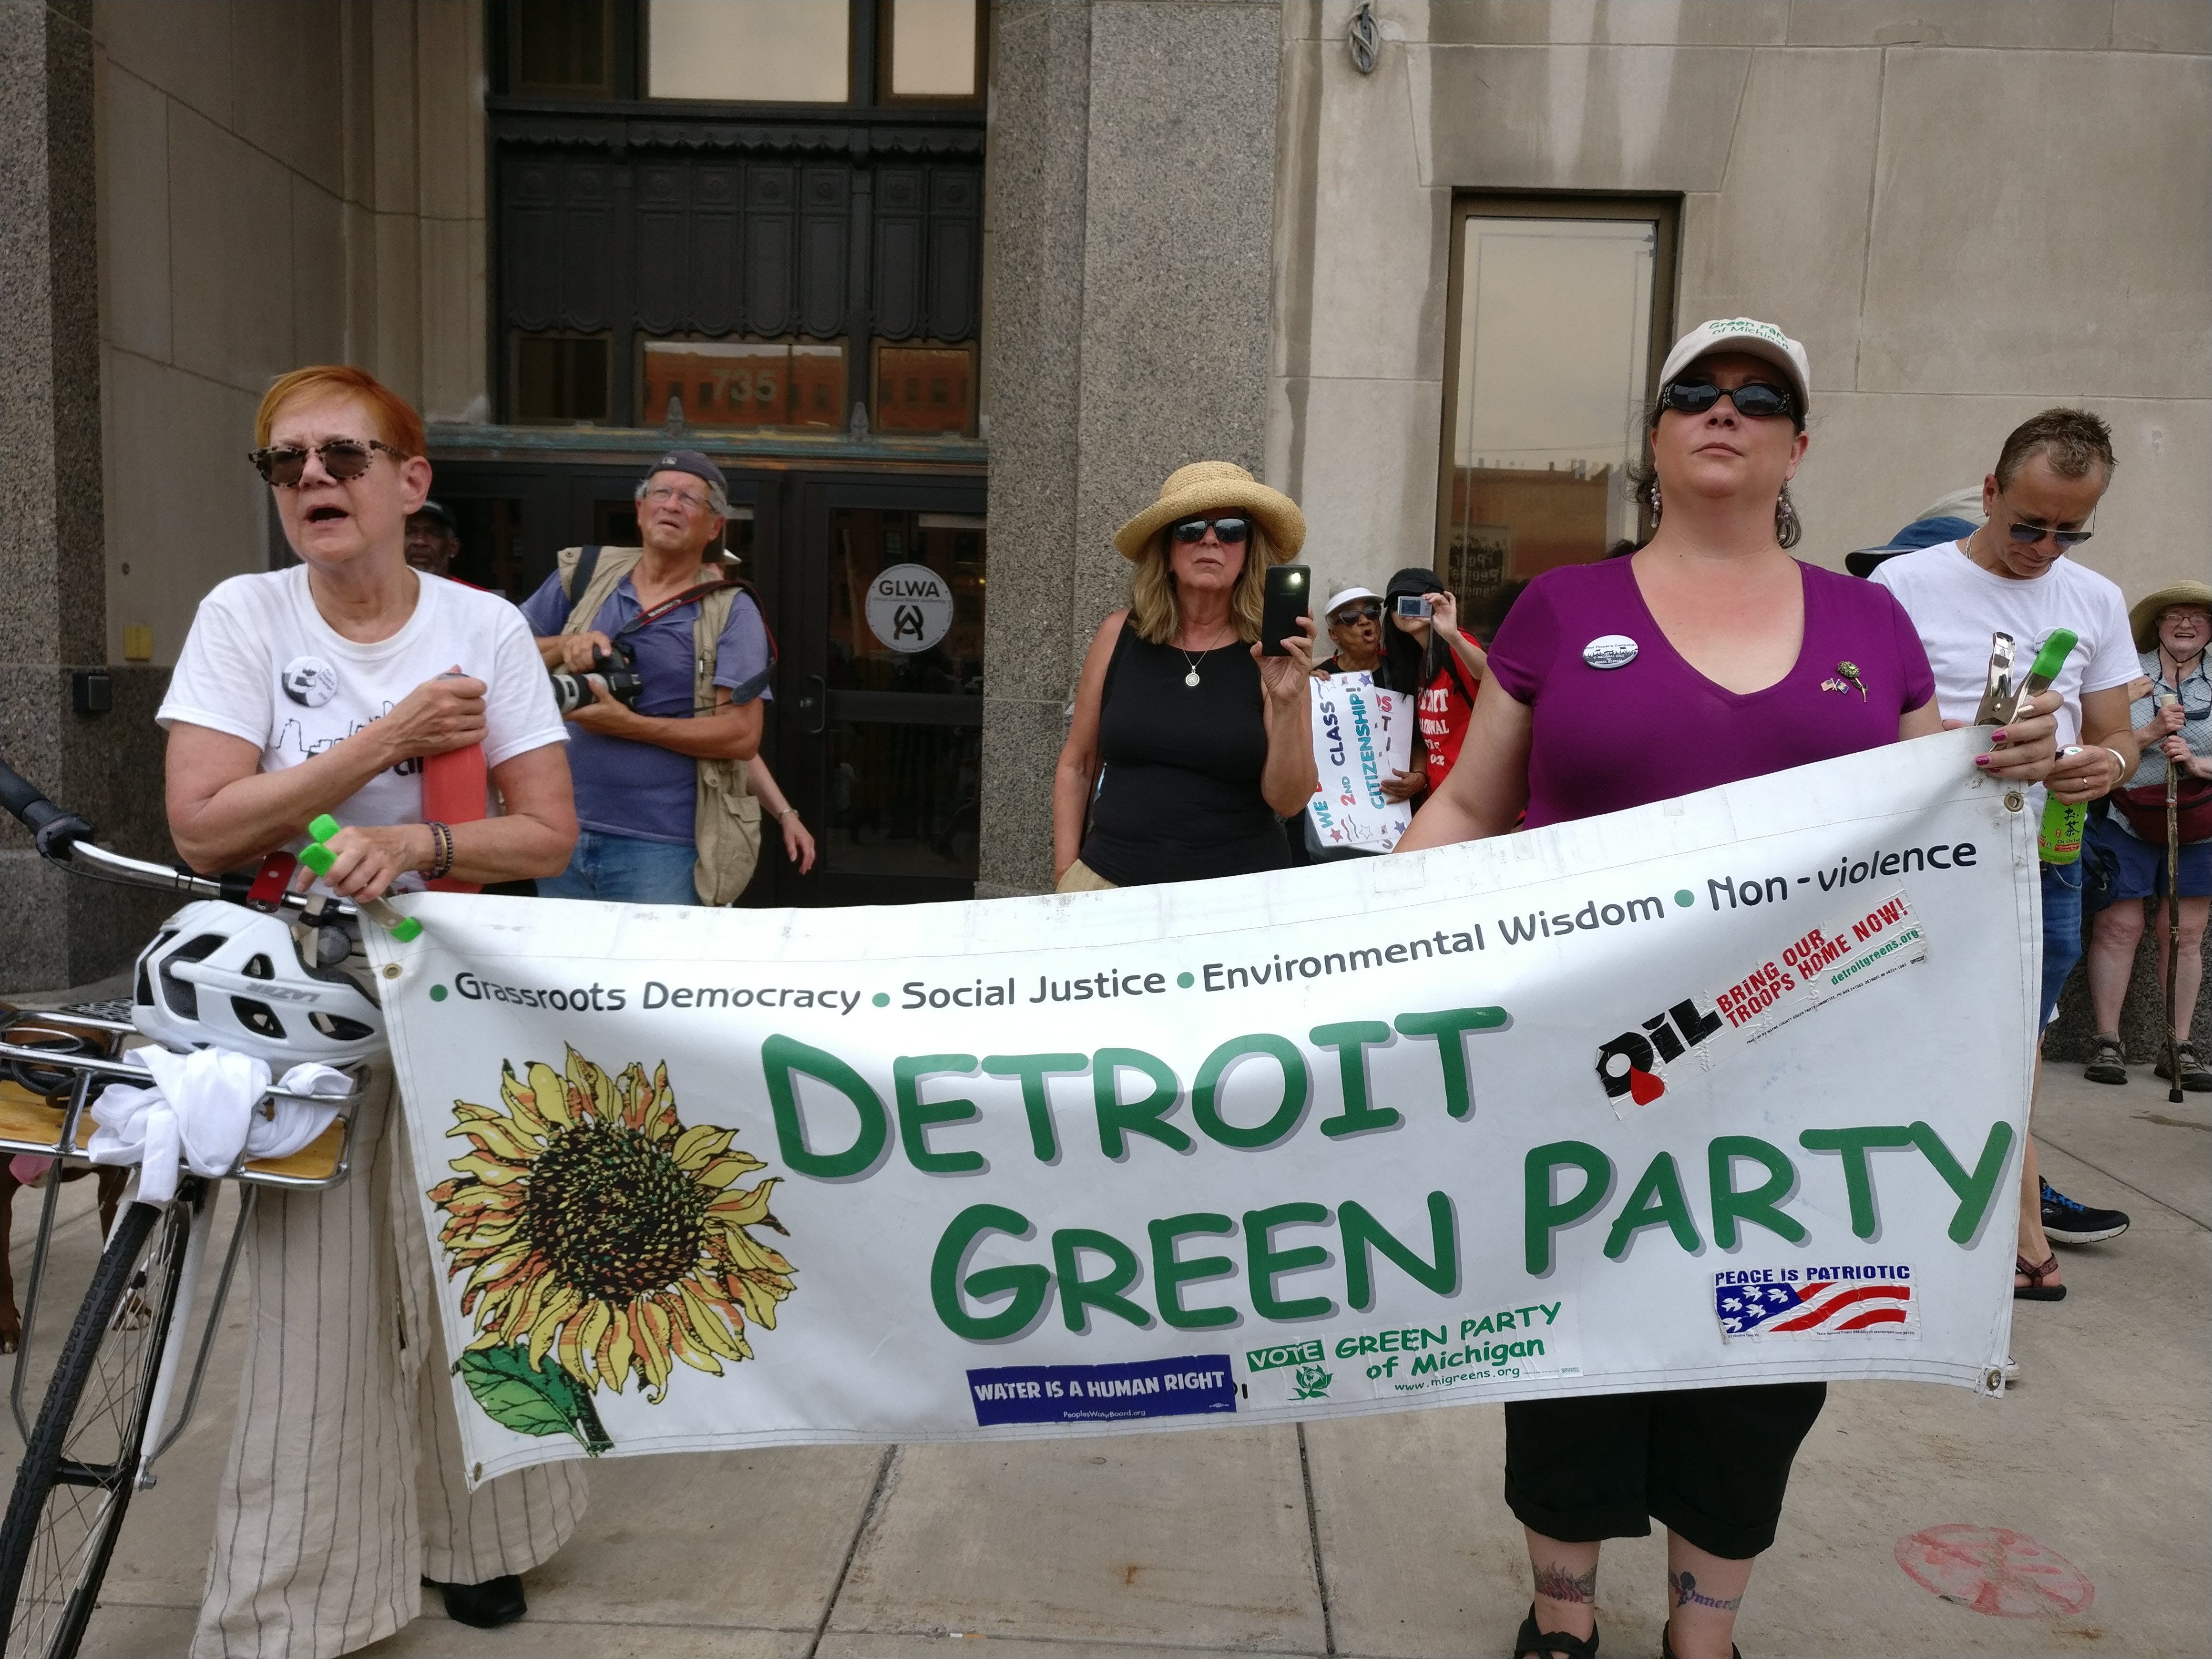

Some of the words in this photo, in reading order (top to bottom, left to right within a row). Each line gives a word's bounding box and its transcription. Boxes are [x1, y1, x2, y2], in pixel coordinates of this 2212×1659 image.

[710, 369, 777, 402] 735
[879, 580, 940, 597] GLWA
[1320, 701, 1345, 766] CLASS
[1346, 687, 1385, 809] CITIZENSHIP!
[1341, 776, 1356, 806] 2ND
[1313, 800, 1334, 829] WE
[454, 972, 626, 1012] Grassroots
[643, 981, 861, 1016] Democracy
[901, 977, 1014, 1009] Social
[1029, 968, 1166, 1003] Justice
[1203, 923, 1485, 992] Environmental
[1498, 895, 1664, 946] Wisdom
[1726, 973, 1795, 1028] TROOPS
[1797, 933, 1852, 980] HOME
[1852, 897, 1909, 942] NOW!
[1782, 928, 1826, 967] OUR
[1831, 929, 1919, 985] detroitgreens.org
[1779, 1017, 1792, 1029] COUNTY
[762, 1006, 1512, 1183] DETROIT
[931, 1191, 1461, 1344] GREEN
[1525, 1121, 2016, 1279] PARTY
[1716, 1269, 1773, 1286] PEACE
[1807, 1265, 1910, 1280] PATRIOTIC
[1335, 1325, 1448, 1359] GREEN
[1460, 1301, 1561, 1341] PARTY
[1251, 1341, 1321, 1368] VOTE
[1366, 1357, 1399, 1380] of
[1411, 1338, 1545, 1377] Michigan
[974, 1382, 1041, 1401] WATER
[1045, 1381, 1064, 1398] IS
[1069, 1381, 1084, 1397] A
[1088, 1376, 1159, 1398] HUMAN
[1165, 1371, 1225, 1391] RIGHT
[1395, 1365, 1520, 1391] www.migreens.org
